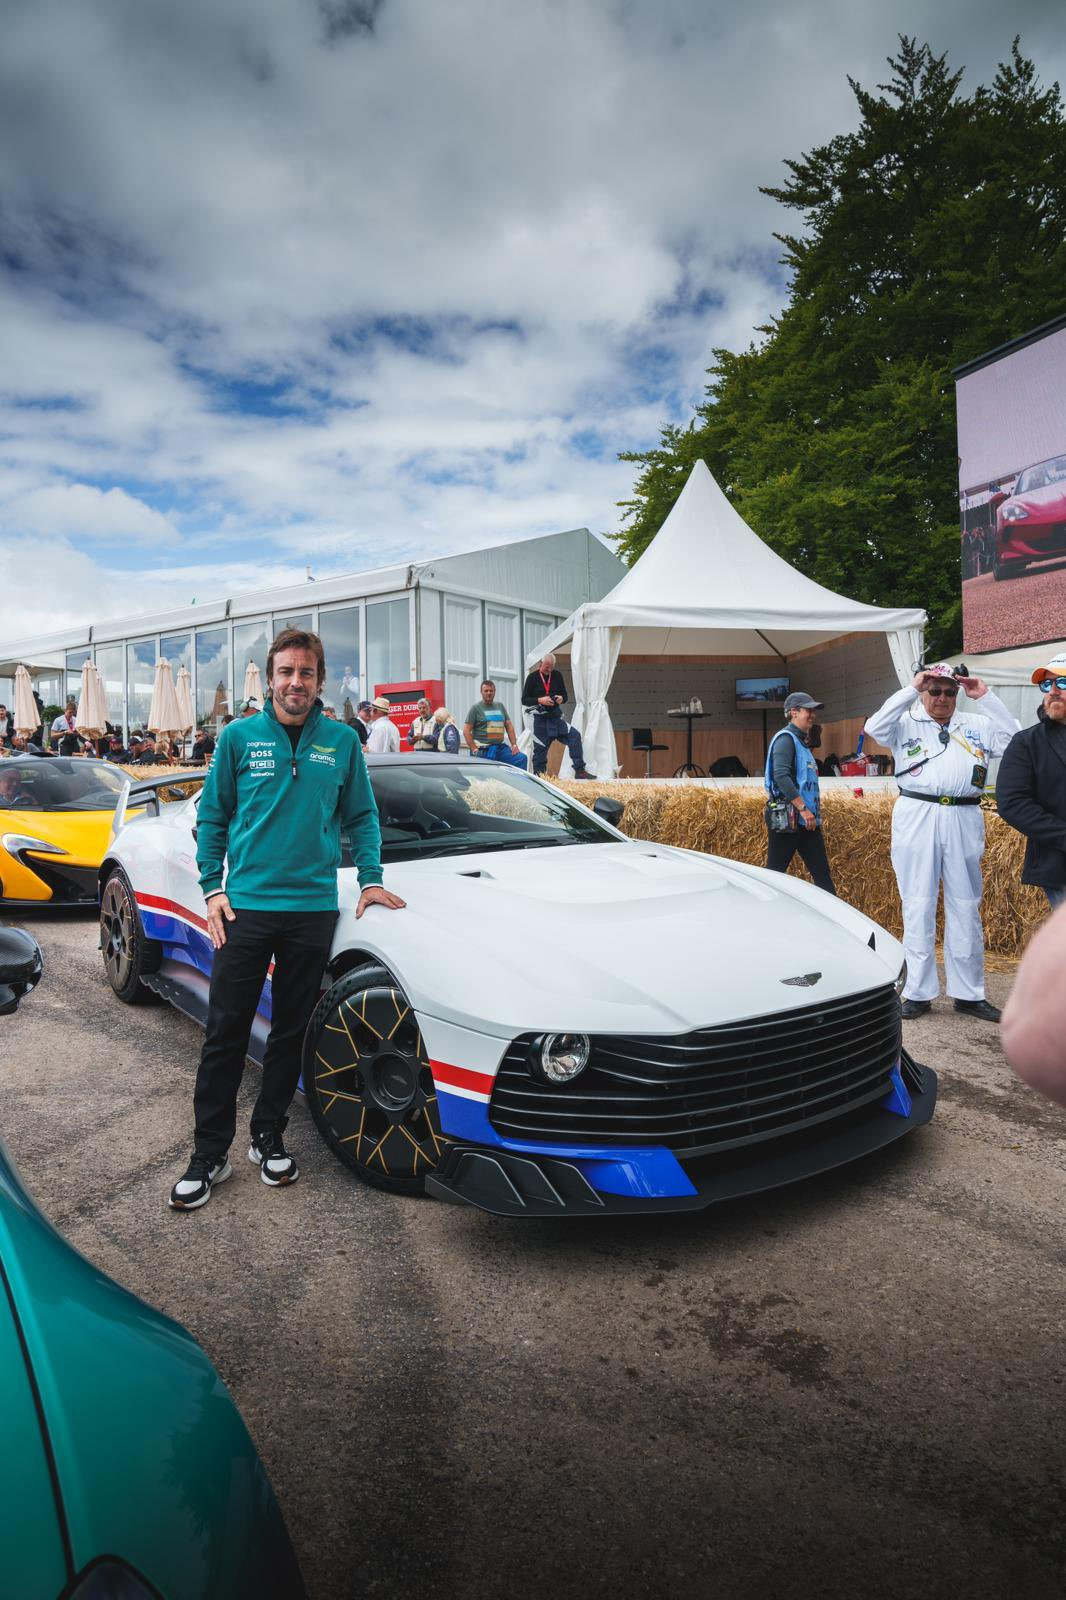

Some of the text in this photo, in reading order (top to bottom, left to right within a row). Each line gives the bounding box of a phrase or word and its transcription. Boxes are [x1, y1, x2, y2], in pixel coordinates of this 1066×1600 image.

[251, 750, 273, 758] BOSS
[310, 753, 336, 763] aramco
[250, 760, 275, 769] JCB
